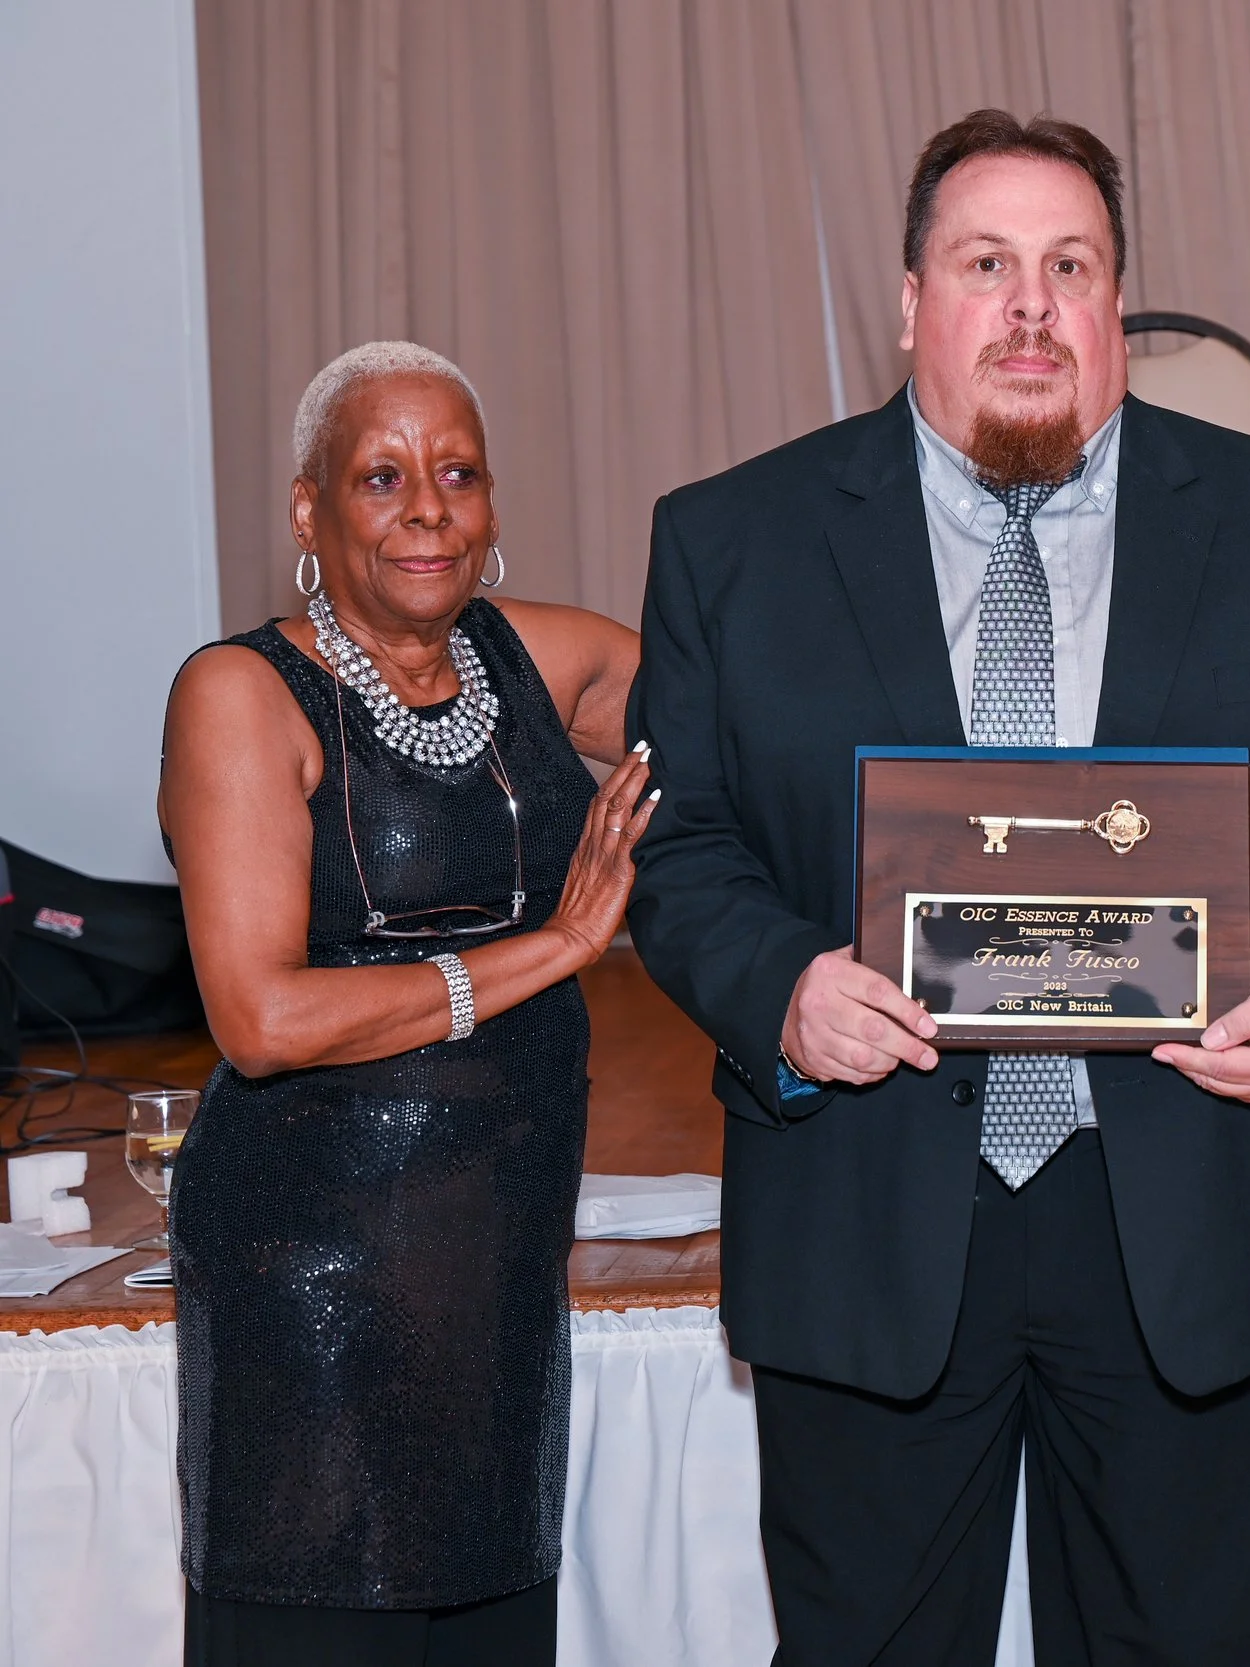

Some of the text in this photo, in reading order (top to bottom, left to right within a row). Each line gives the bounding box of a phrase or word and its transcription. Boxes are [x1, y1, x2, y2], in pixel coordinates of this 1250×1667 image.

[960, 907, 1153, 925] OIC ESSENCE AWARD
[1019, 926, 1075, 937] PRESENTED
[971, 947, 1140, 969] Frank Fusco
[1043, 981, 1068, 991] 2023
[996, 1000, 1113, 1013] OIC New Britain
